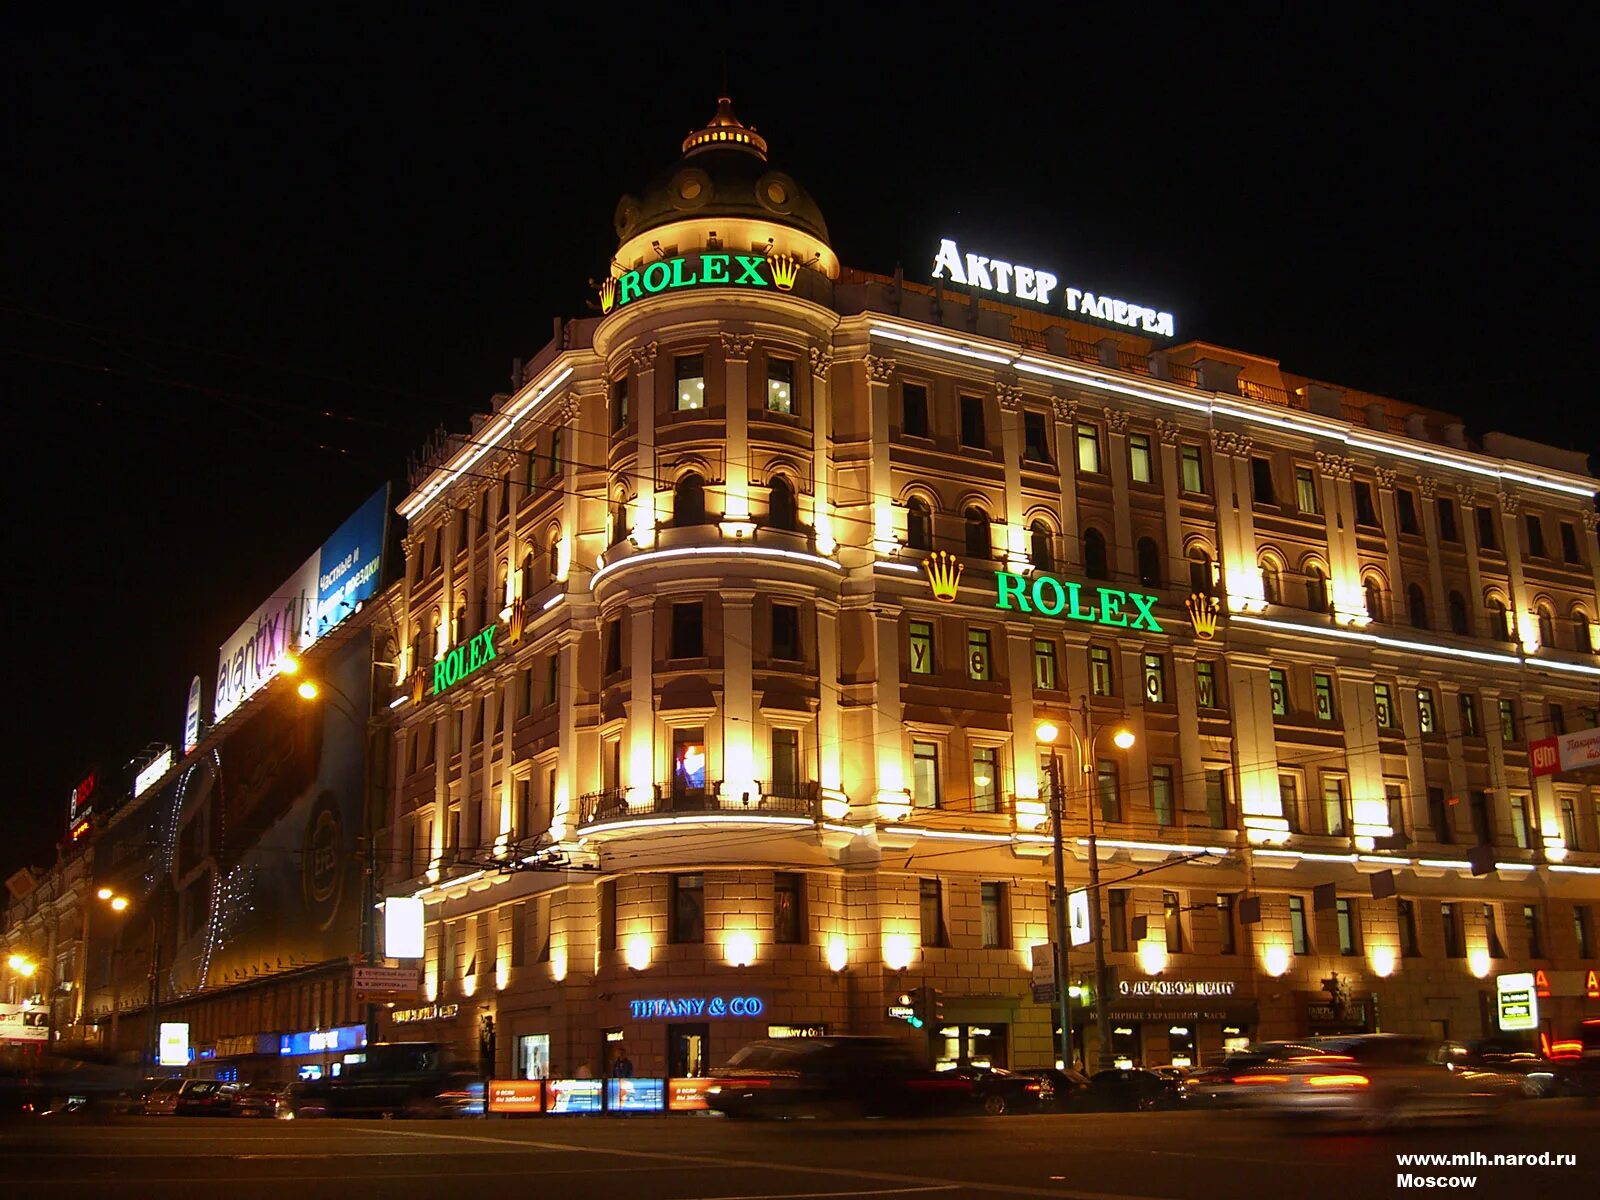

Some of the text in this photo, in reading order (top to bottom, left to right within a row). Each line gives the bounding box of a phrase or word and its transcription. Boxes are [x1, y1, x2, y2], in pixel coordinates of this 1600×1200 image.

[619, 254, 769, 305] ROLEX
[994, 571, 1163, 633] ROLEX
[433, 625, 497, 696] ROLEX
[629, 997, 764, 1018] TIFFANY & CO
